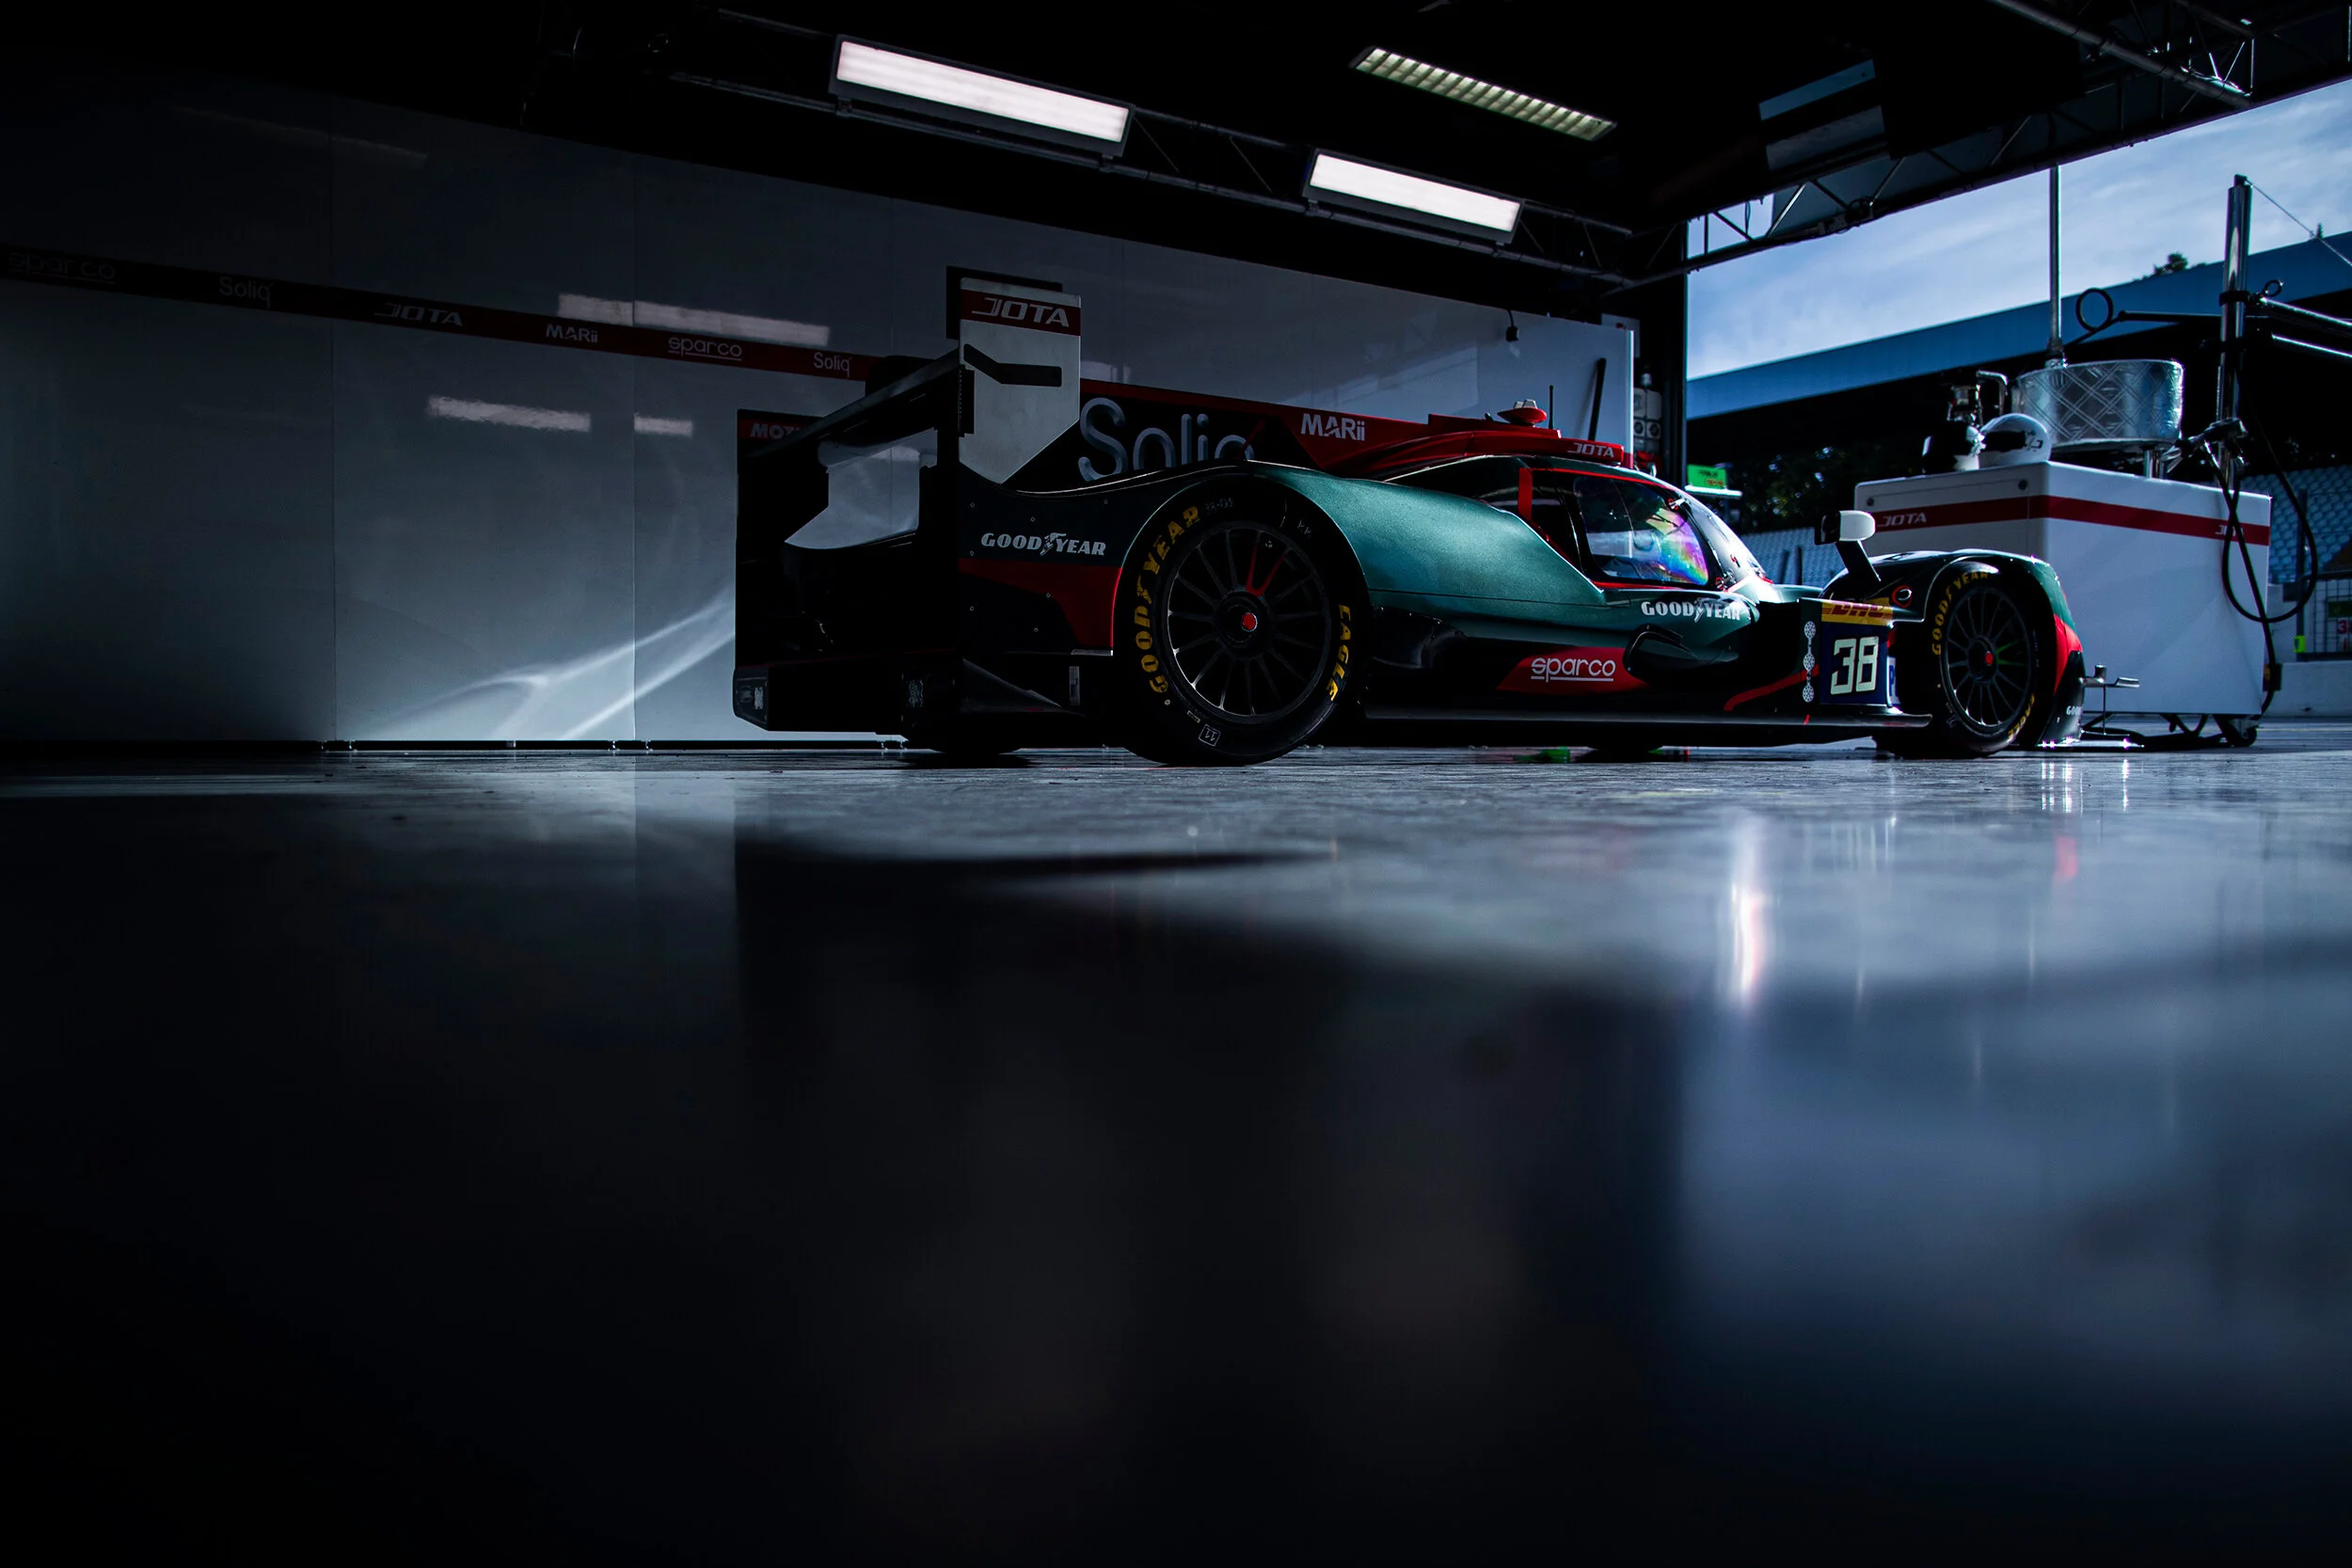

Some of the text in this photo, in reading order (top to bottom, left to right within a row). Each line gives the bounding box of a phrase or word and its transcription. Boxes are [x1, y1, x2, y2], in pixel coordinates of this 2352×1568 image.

[8, 251, 117, 284] sparco
[373, 302, 464, 327] JOTA
[971, 296, 1070, 328] JOTA
[667, 336, 742, 362] sparco
[1565, 442, 1615, 458] JOTA
[1877, 512, 1928, 528] JOTA
[1831, 604, 1884, 618] DHL
[1326, 604, 1352, 702] EAGLE
[1830, 636, 1880, 695] 38
[1530, 657, 1616, 683] sparco
